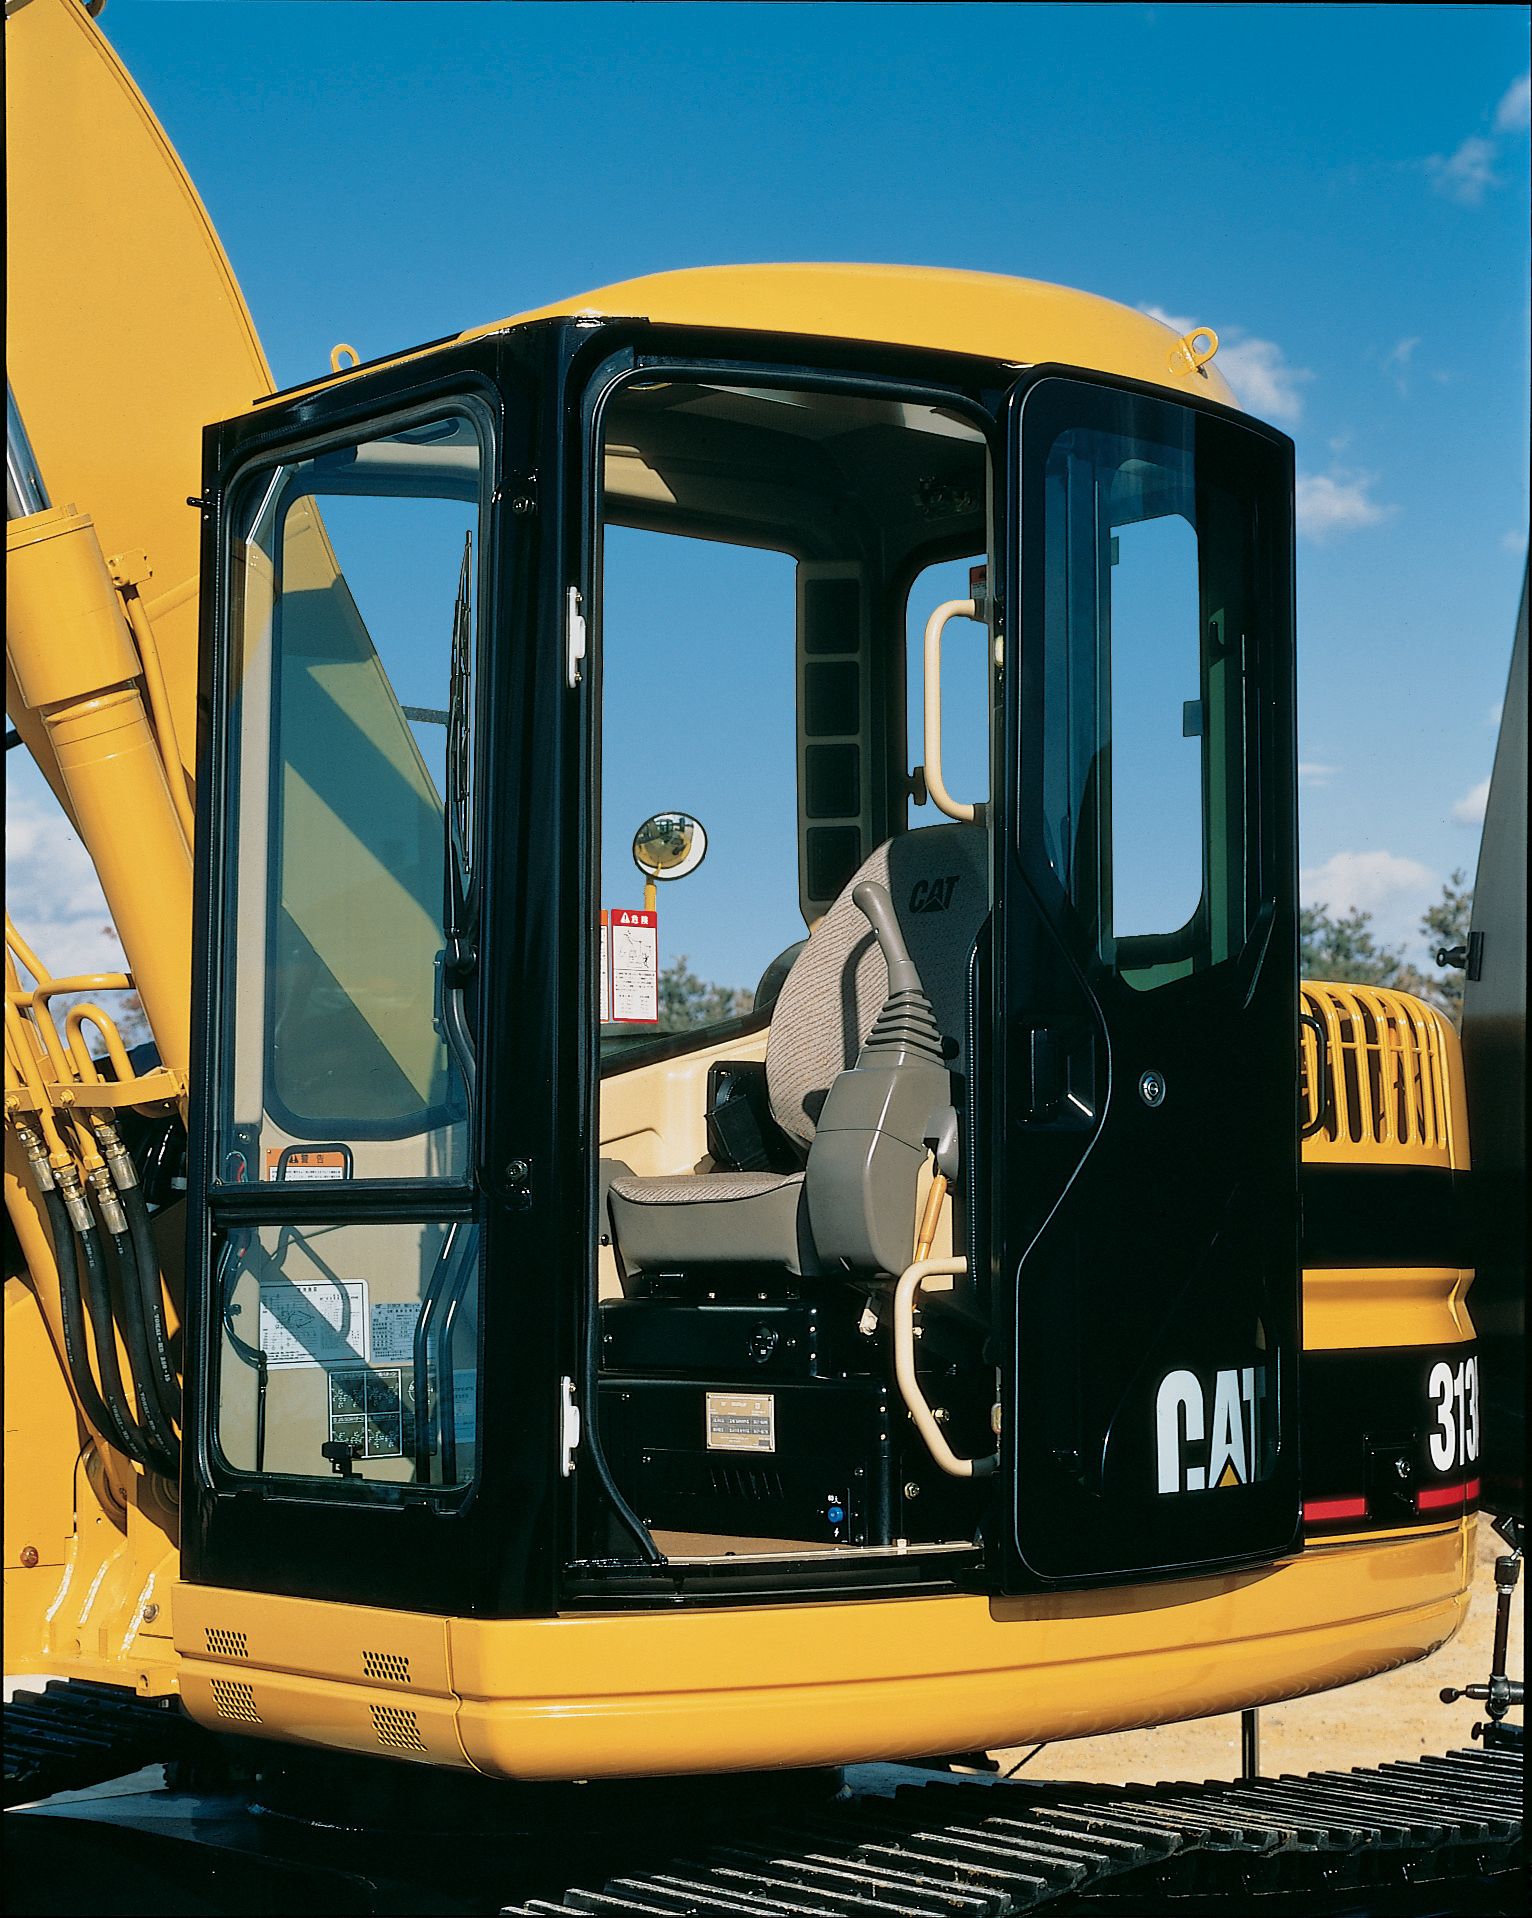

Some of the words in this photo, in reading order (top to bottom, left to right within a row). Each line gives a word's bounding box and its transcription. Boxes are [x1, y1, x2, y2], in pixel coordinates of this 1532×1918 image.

[909, 875, 961, 914] CAT
[1156, 1366, 1266, 1494] CAT
[1429, 1356, 1480, 1472] 313
